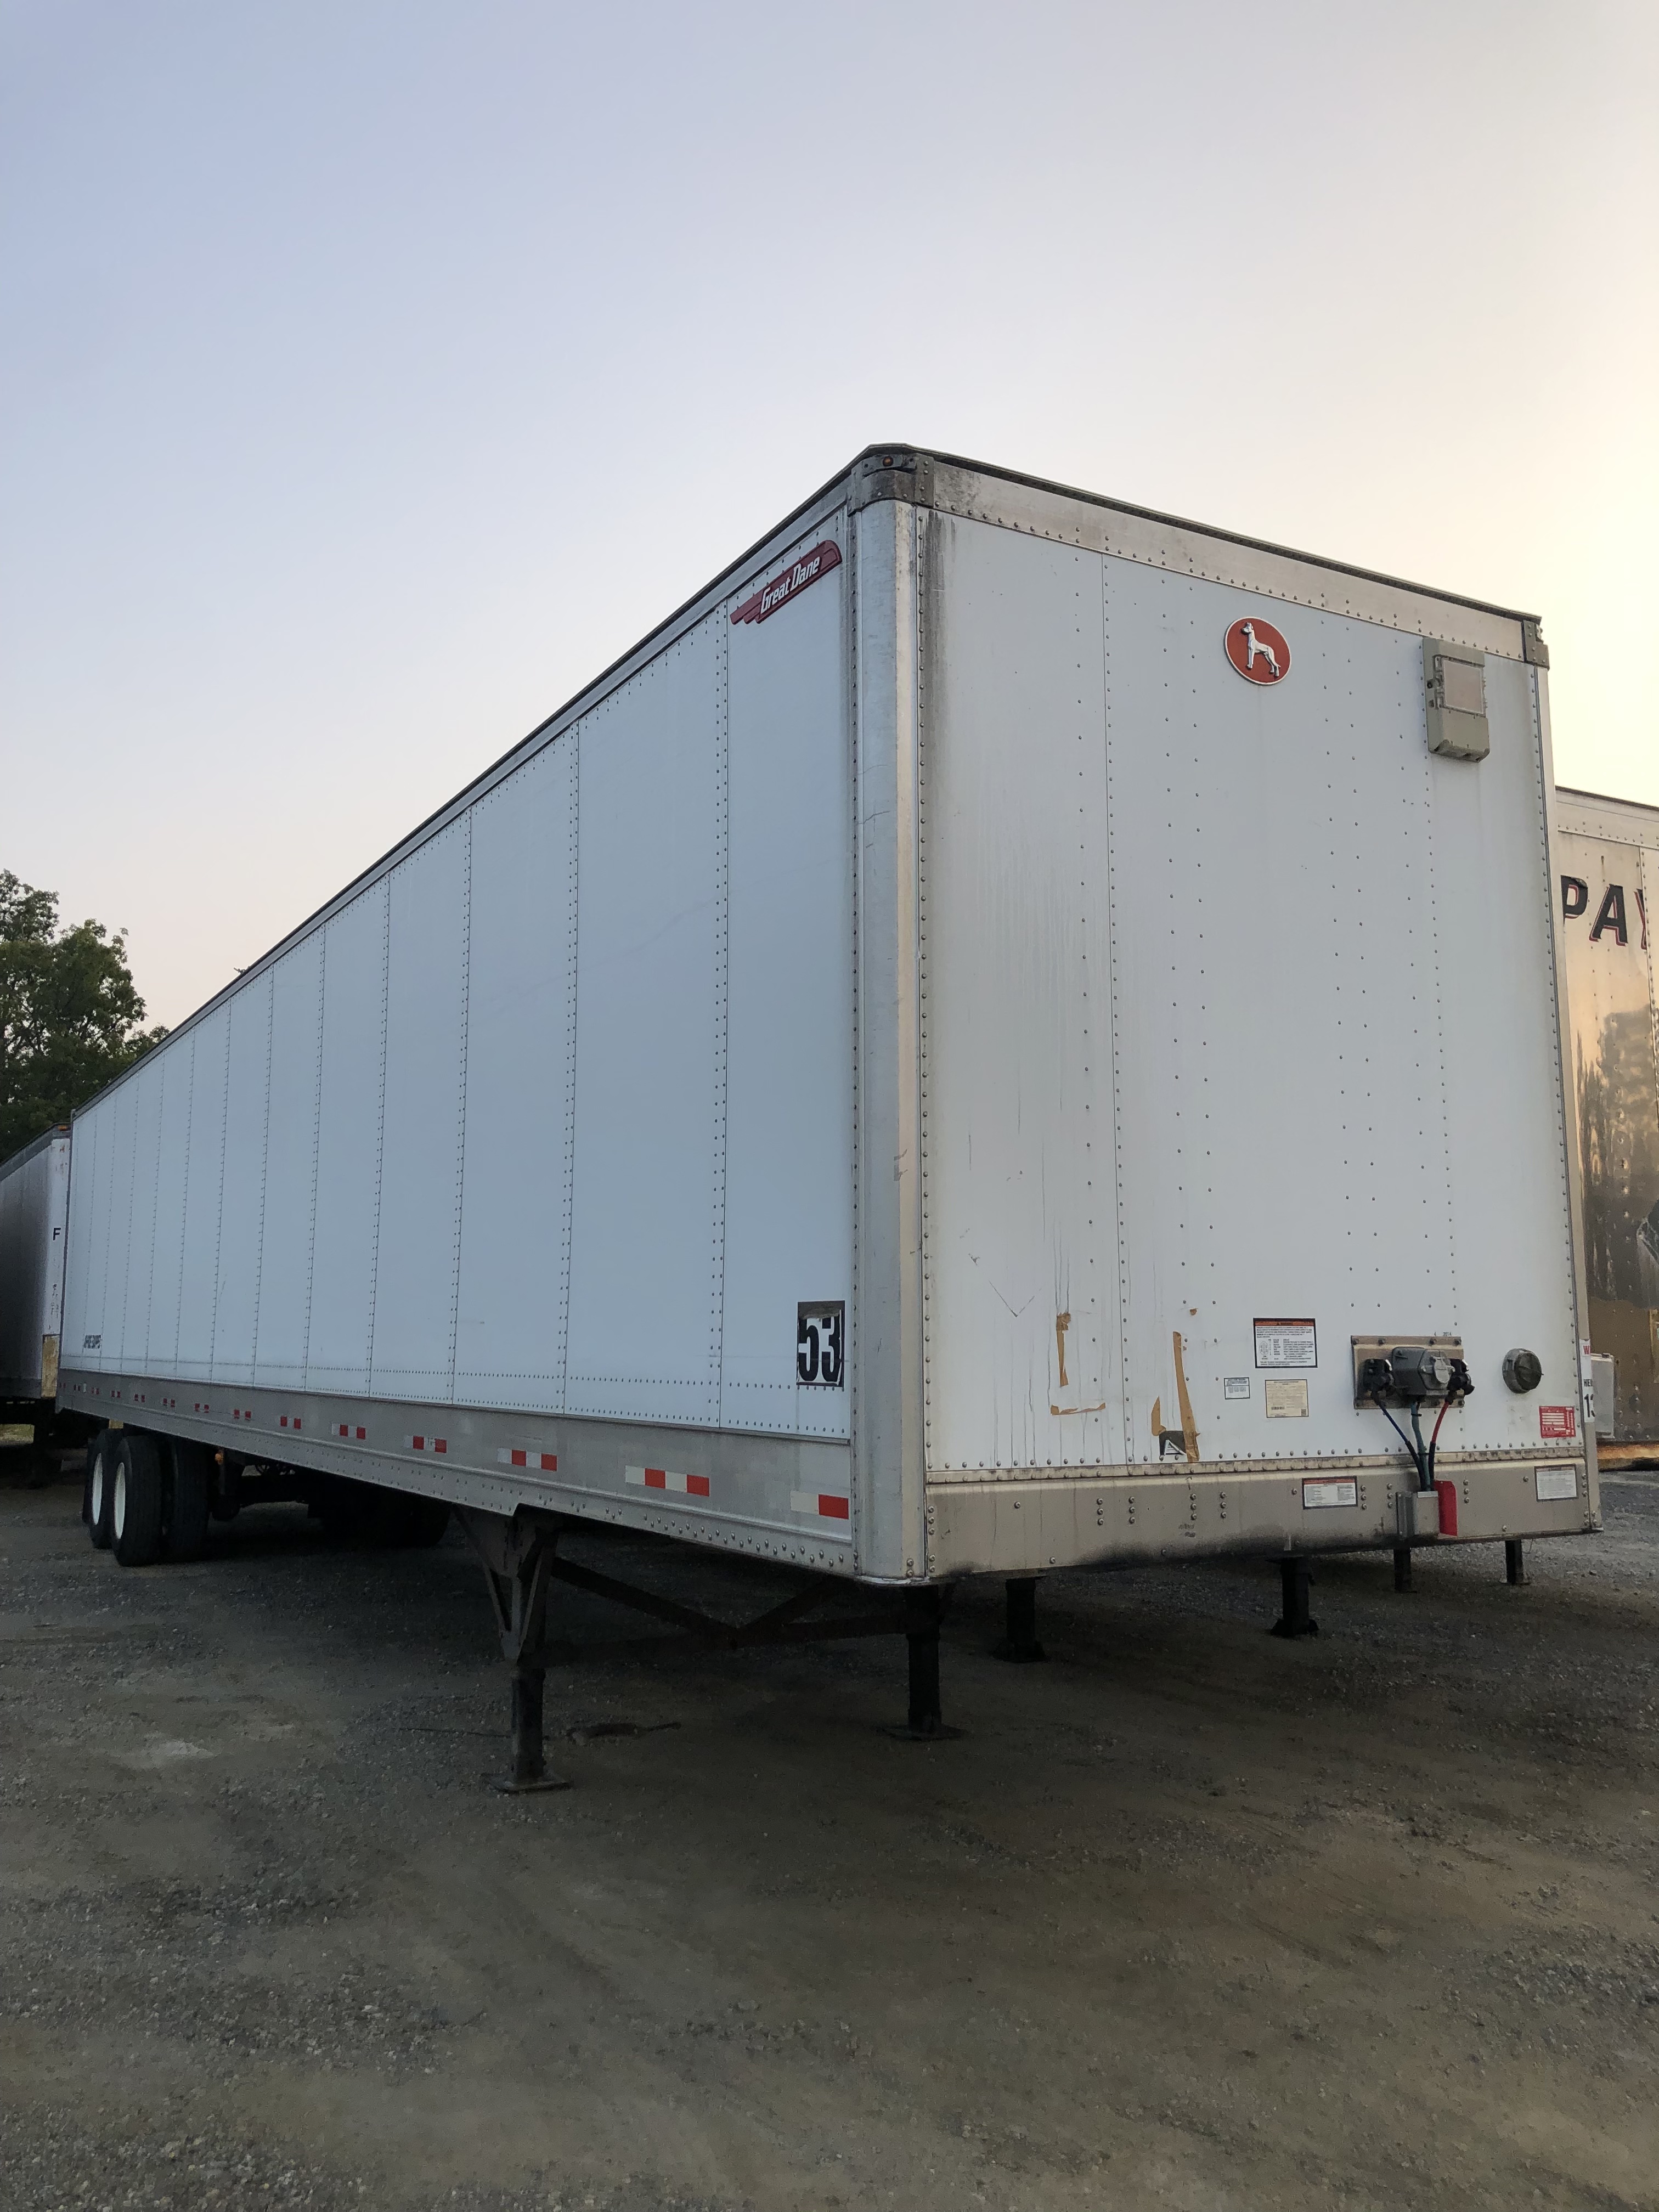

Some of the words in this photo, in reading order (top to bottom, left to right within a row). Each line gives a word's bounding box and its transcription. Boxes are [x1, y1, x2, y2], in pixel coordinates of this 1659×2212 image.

[760, 575, 791, 614] Great
[790, 556, 821, 592] Dane
[53, 1227, 61, 1241] F
[799, 1316, 841, 1383] 53
